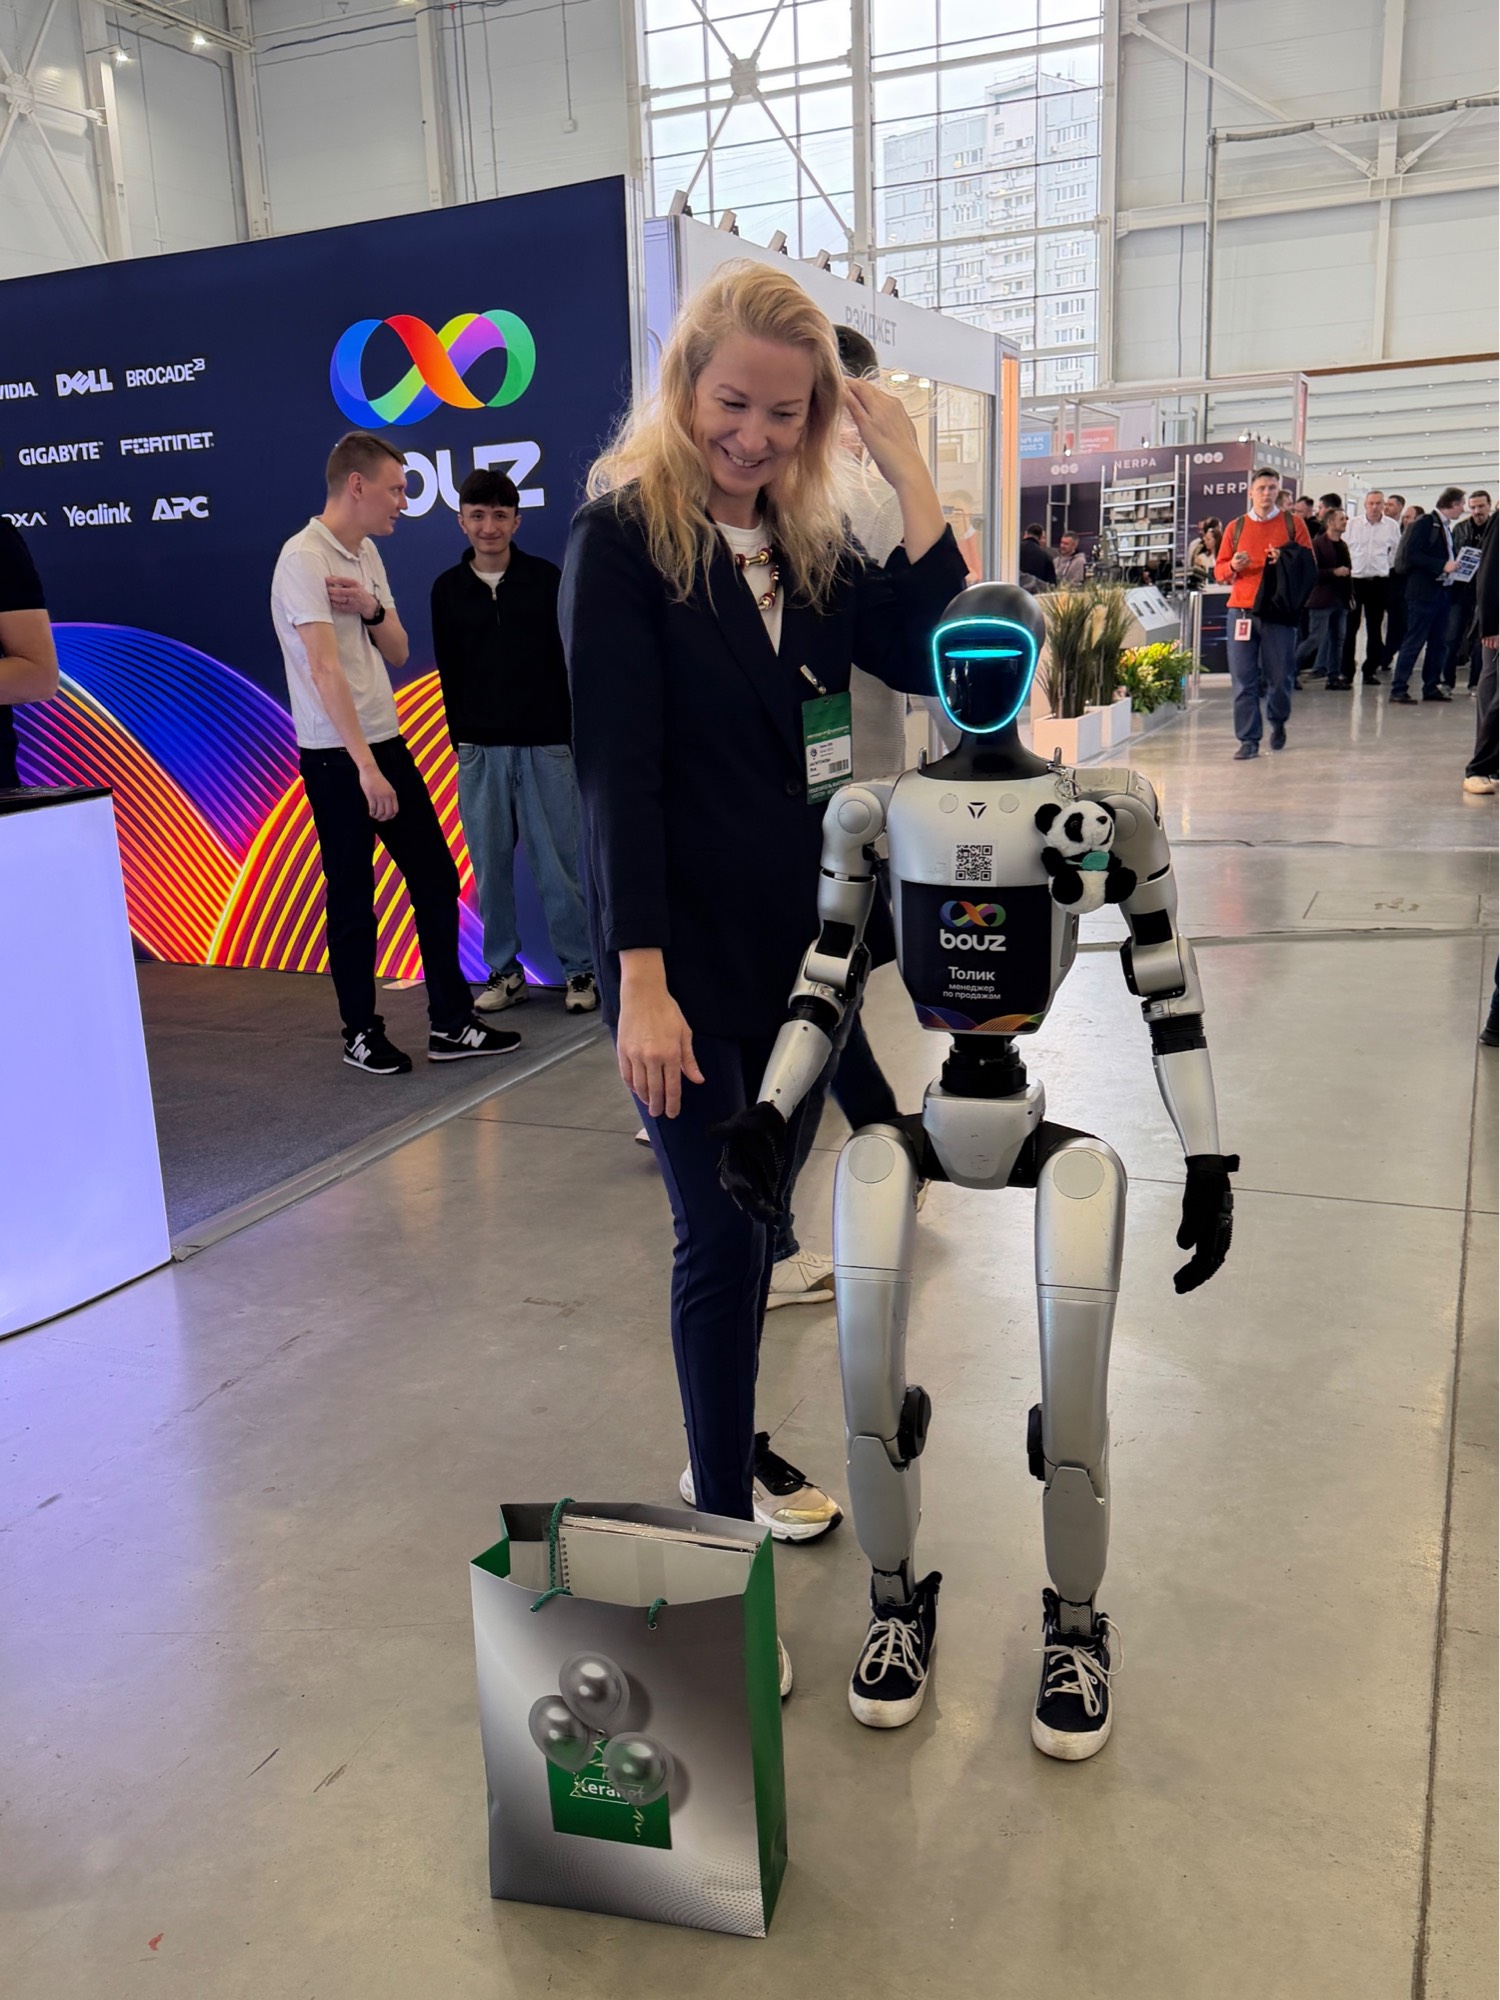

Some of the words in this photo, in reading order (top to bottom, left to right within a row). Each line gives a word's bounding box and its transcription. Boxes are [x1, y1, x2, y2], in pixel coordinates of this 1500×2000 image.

[56, 368, 113, 397] DELL
[18, 441, 103, 466] GIGABYTE
[120, 431, 214, 455] FORTINET
[1114, 457, 1157, 470] NERPA
[401, 440, 545, 518] ouz
[1203, 481, 1248, 496] NERP
[62, 502, 132, 528] Yealink
[151, 495, 210, 521] APC
[939, 928, 1007, 952] bouz
[947, 965, 997, 982] Толик
[942, 990, 954, 998] по
[954, 992, 1002, 1000] продажам
[948, 984, 996, 994] менеджер
